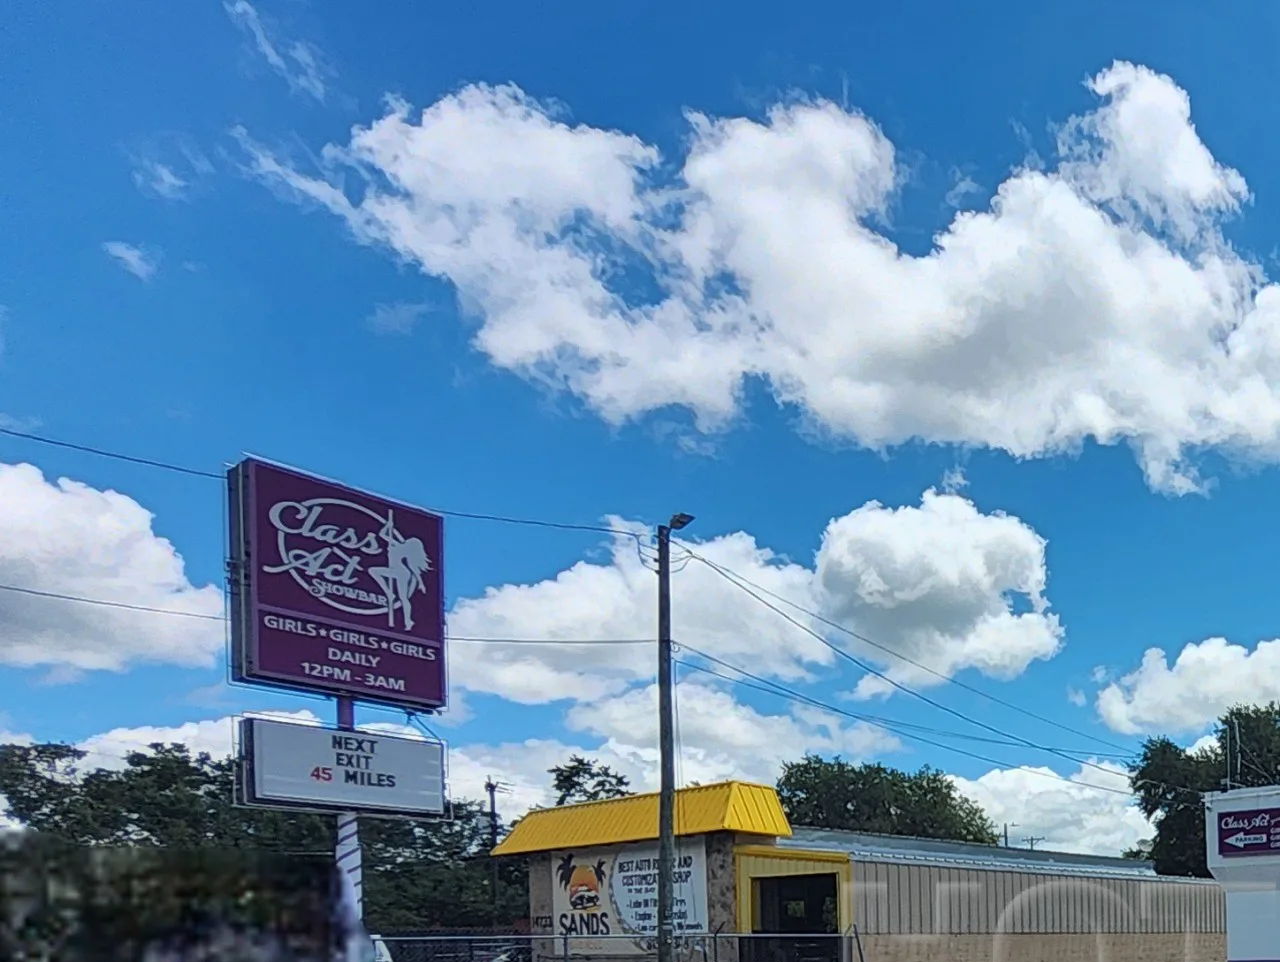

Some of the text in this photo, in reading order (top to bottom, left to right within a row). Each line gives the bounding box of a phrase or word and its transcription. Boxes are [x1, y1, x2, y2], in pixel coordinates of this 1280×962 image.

[269, 501, 382, 555] Class
[262, 547, 364, 585] Act
[263, 615, 436, 661] GIRLS GIRLS GIRLS
[328, 648, 381, 668] DAILY
[332, 735, 379, 754] NEXT
[336, 752, 373, 769] EXIT
[310, 767, 396, 787] 45 MILES
[1221, 815, 1249, 829] Class
[1235, 835, 1264, 843] PARKING
[618, 860, 634, 873] BEST
[559, 911, 611, 936] SANDS
